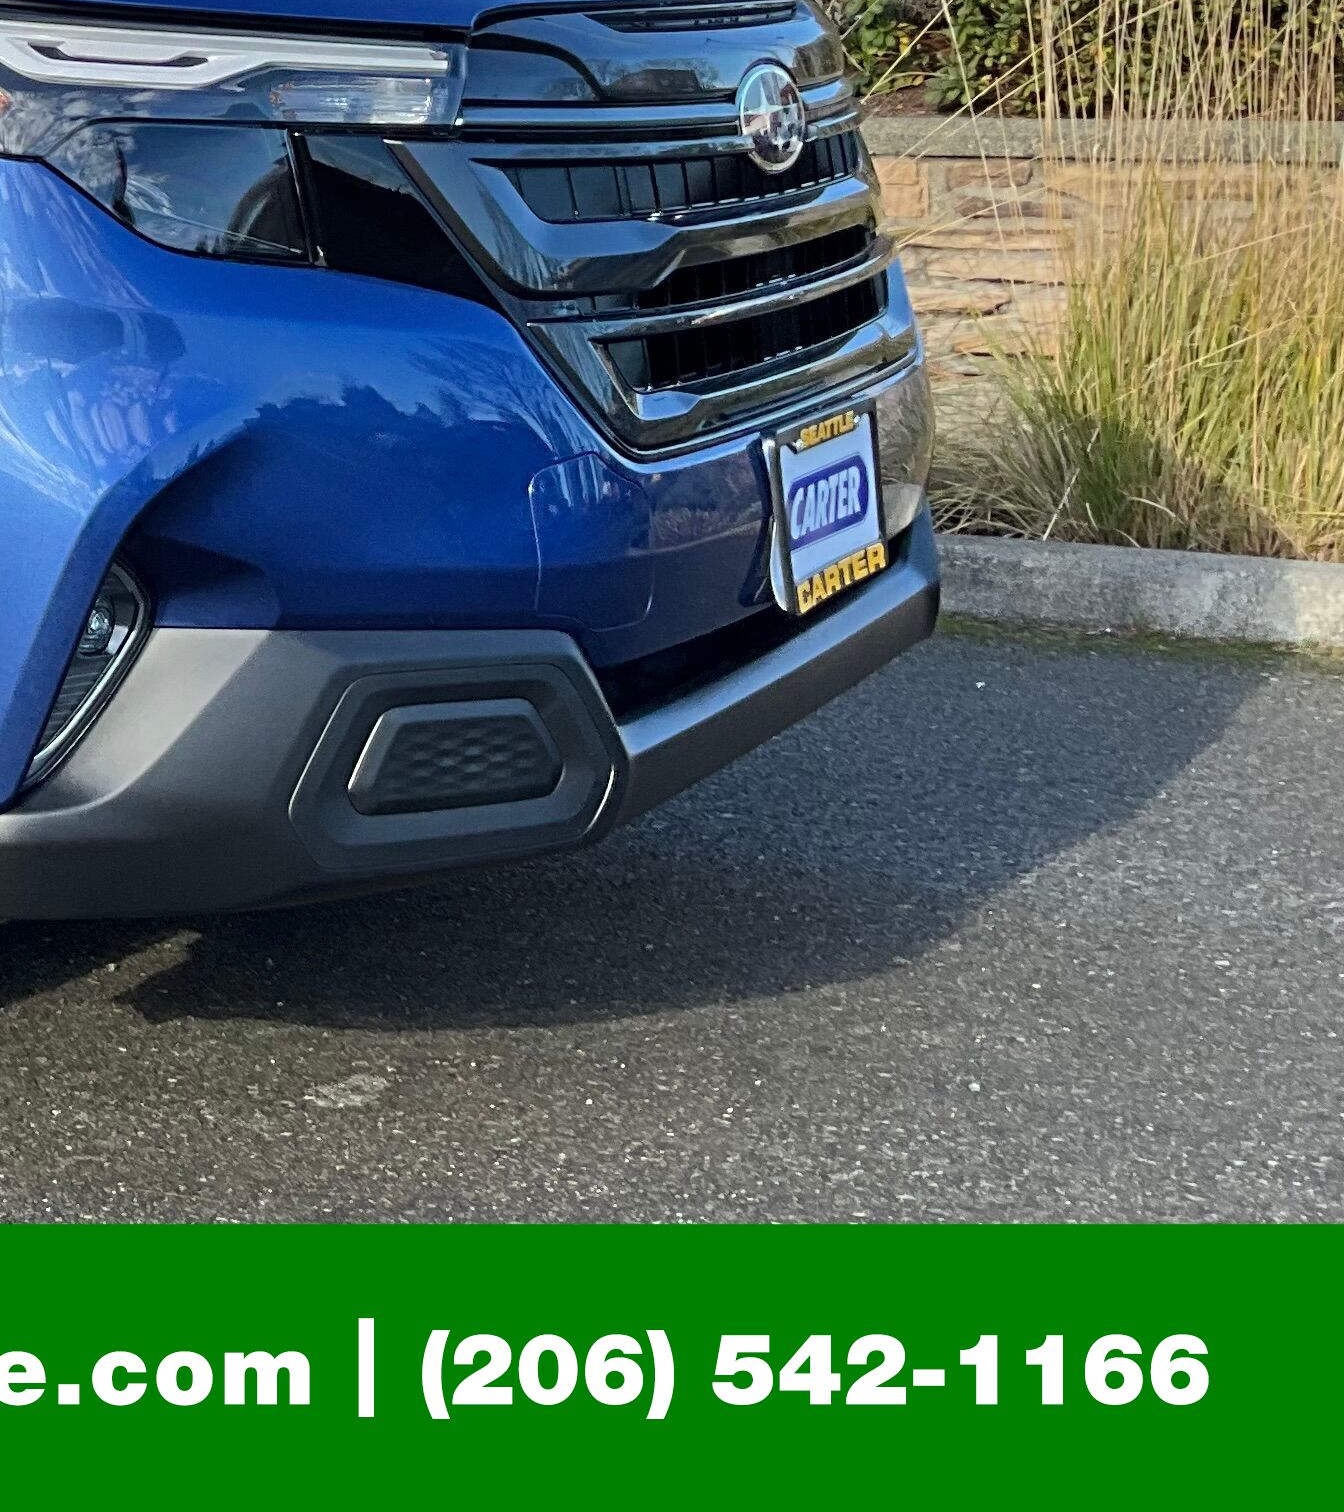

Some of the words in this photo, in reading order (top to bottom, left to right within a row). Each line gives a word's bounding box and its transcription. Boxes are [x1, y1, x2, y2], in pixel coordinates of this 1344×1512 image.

[800, 410, 854, 448] SEATTLE
[790, 465, 862, 540] CARTER
[797, 543, 886, 613] CARTER
